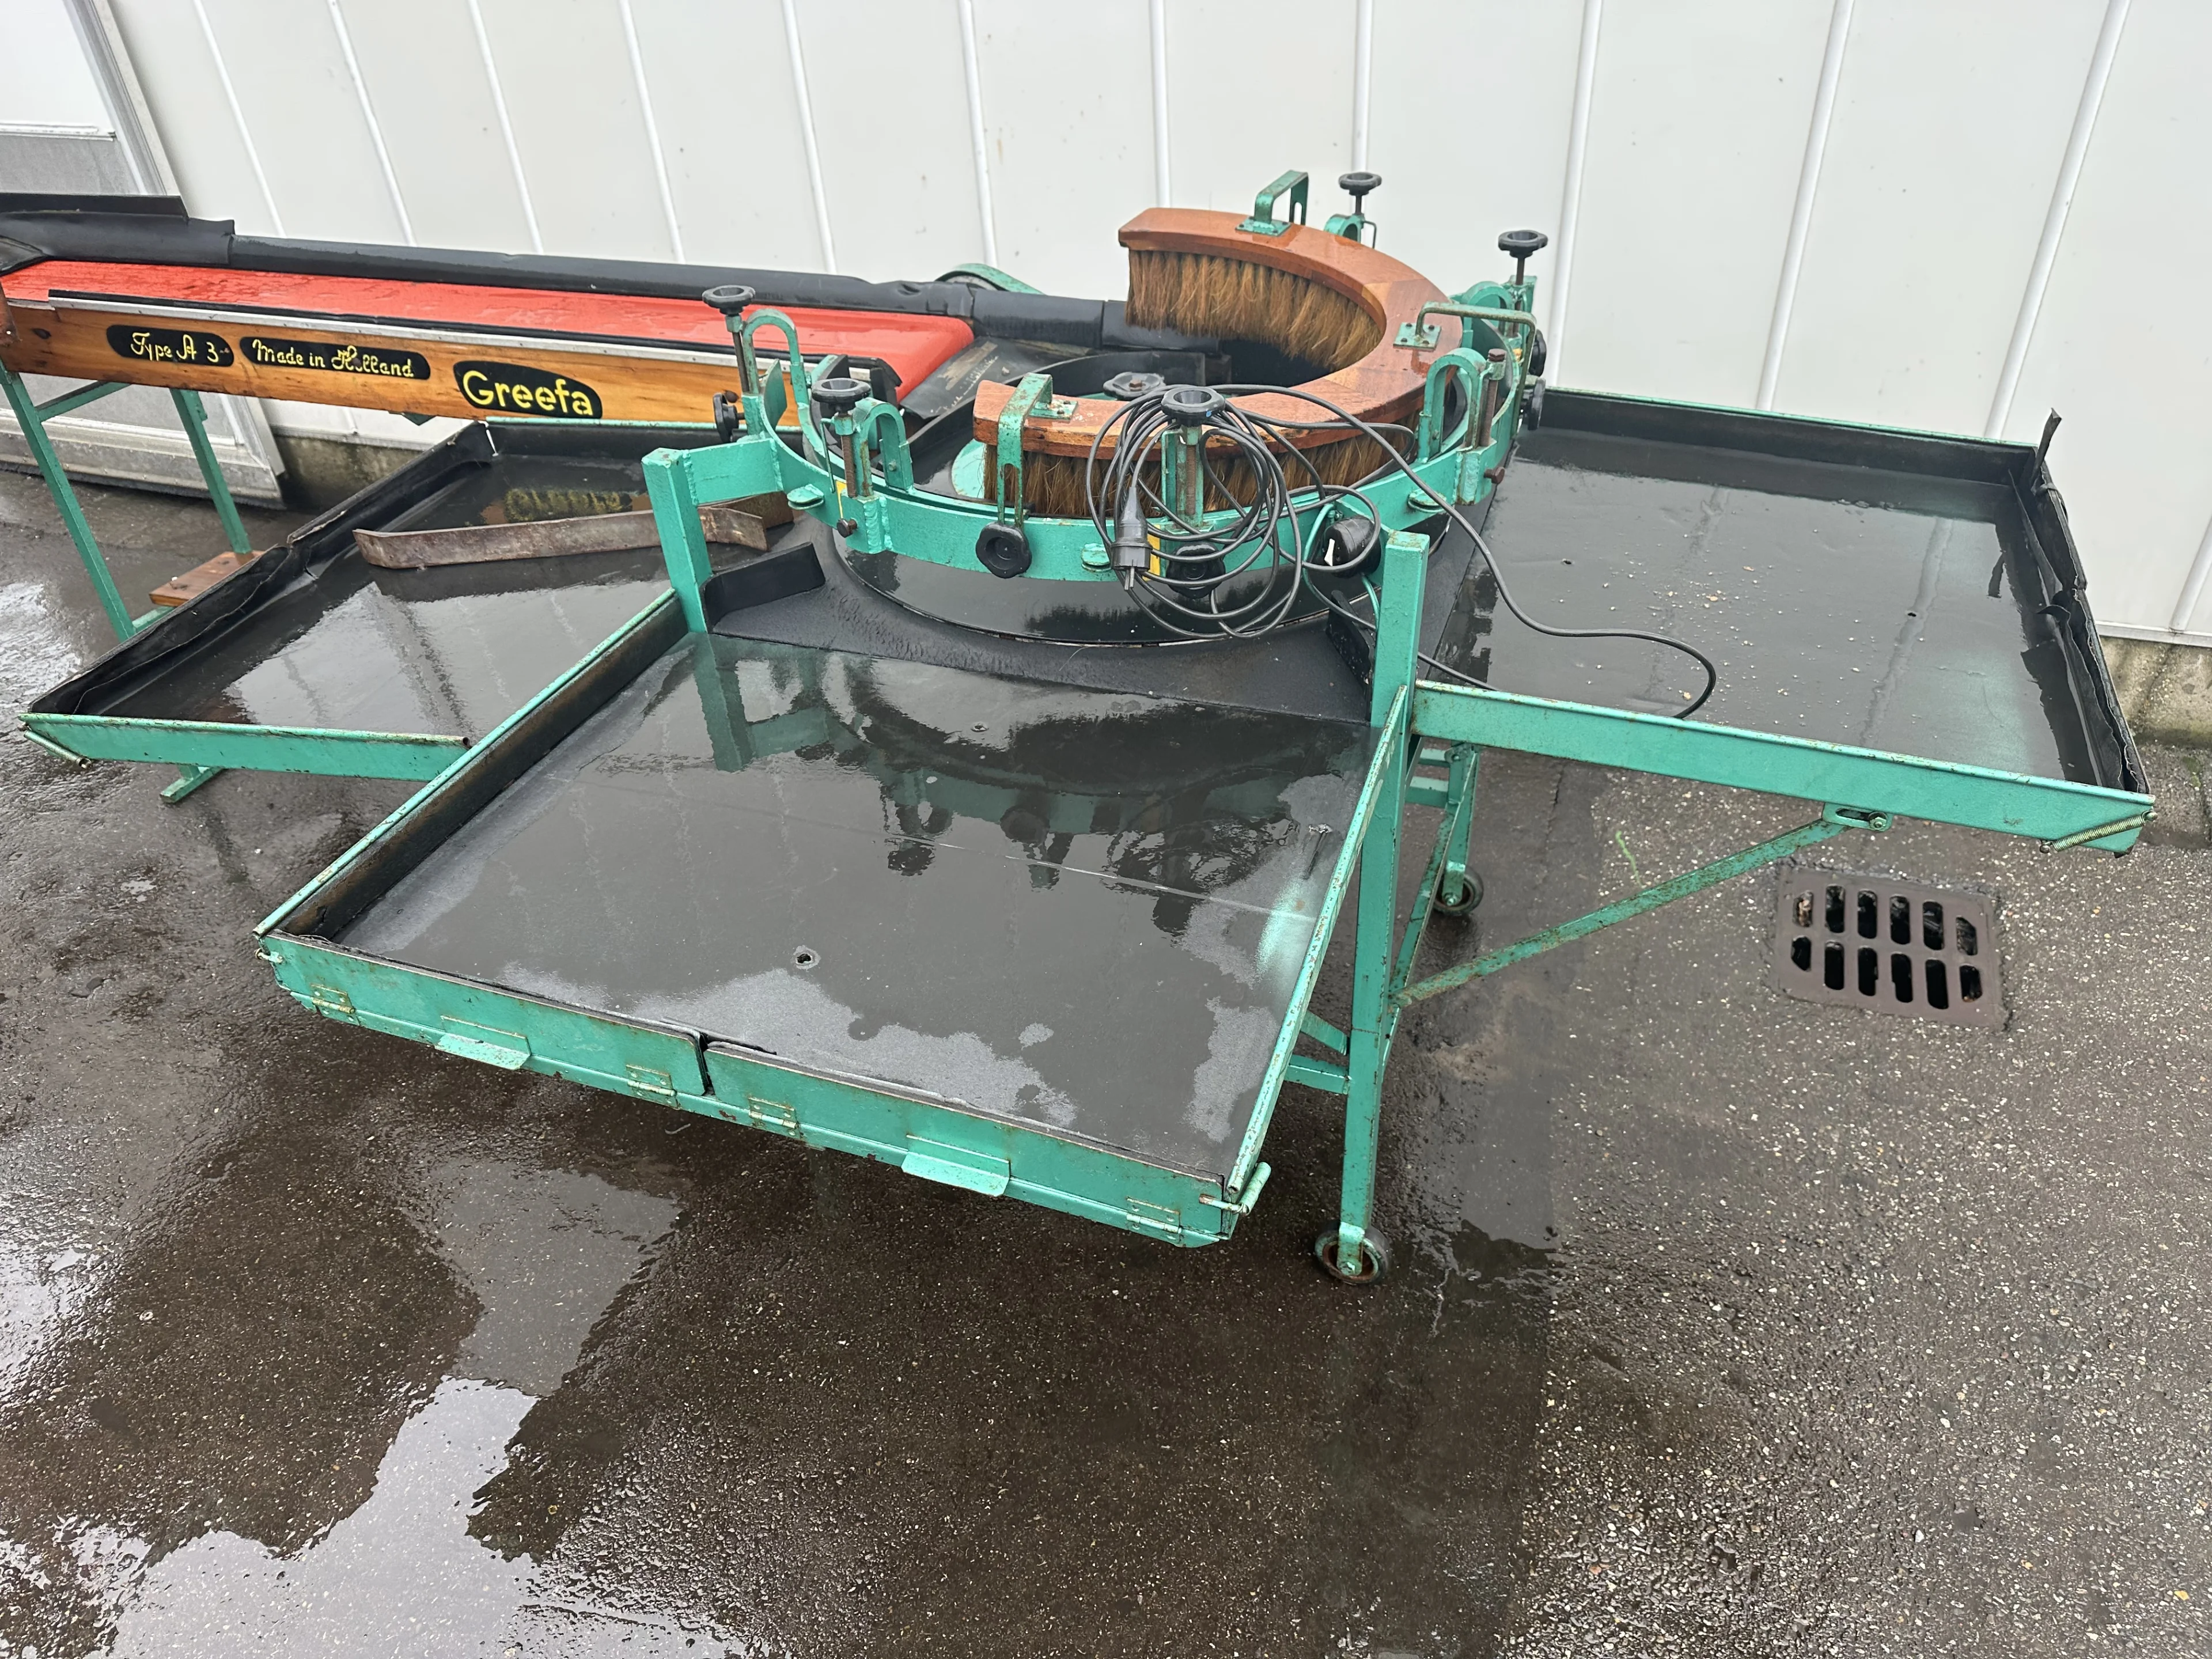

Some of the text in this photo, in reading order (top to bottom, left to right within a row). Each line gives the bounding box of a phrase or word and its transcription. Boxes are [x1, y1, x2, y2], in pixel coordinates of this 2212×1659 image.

[131, 332, 219, 363] Type A 3
[252, 339, 304, 365] Made
[309, 352, 325, 368] in
[463, 370, 593, 416] Greefa
